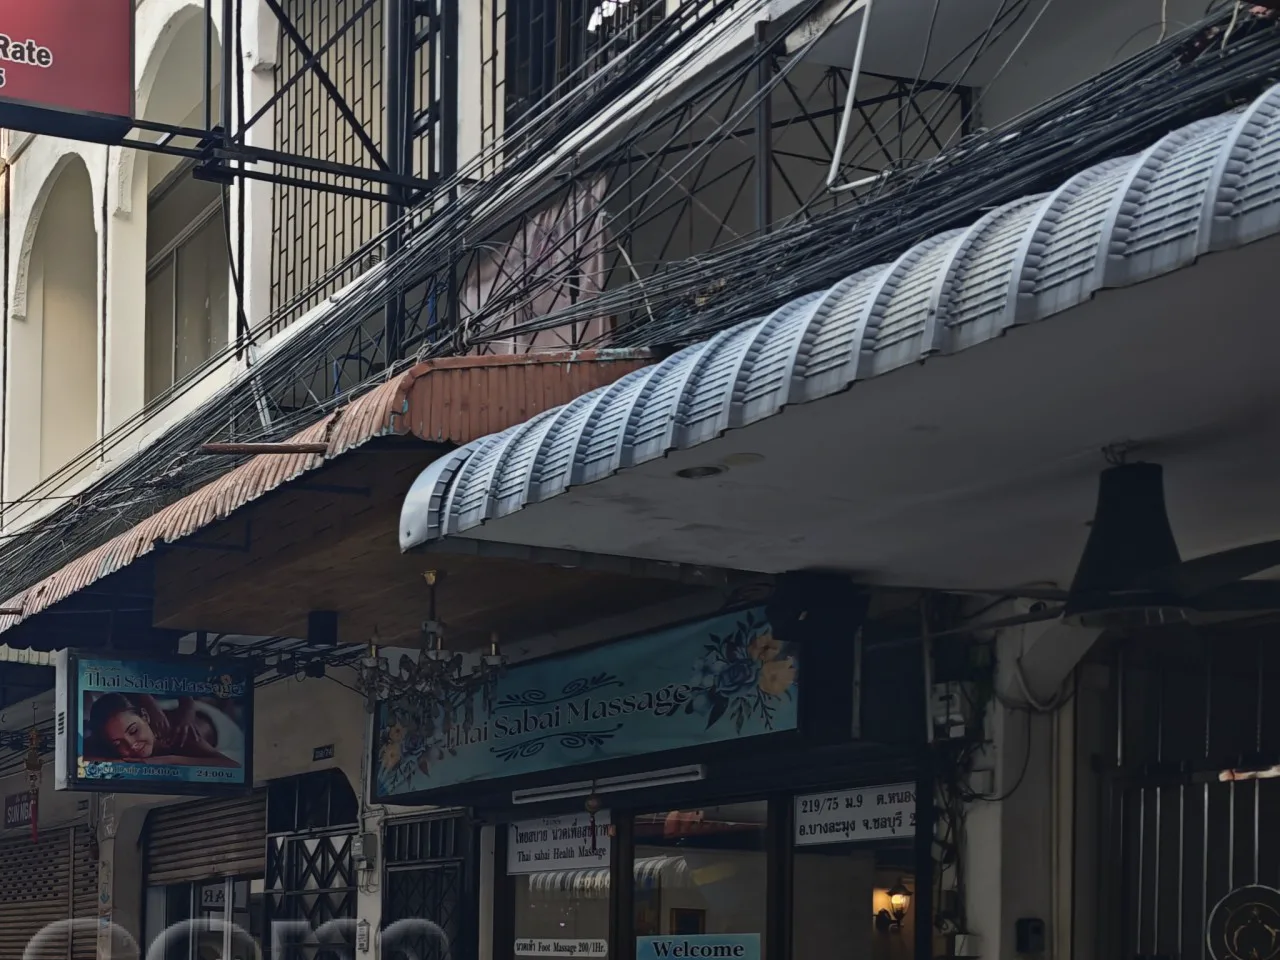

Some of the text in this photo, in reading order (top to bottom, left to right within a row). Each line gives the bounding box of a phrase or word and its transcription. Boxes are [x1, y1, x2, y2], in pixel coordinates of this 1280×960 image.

[84, 671, 244, 697] Thai Sabai Massage
[493, 709, 560, 741] Sabai
[567, 681, 692, 725] Massage
[802, 797, 839, 815] 219/75
[517, 851, 531, 862] Thai
[534, 848, 550, 860] sabai
[554, 847, 574, 860] Health
[538, 942, 550, 951] Foot
[553, 942, 577, 955] Massage
[652, 941, 744, 957] Welcome
